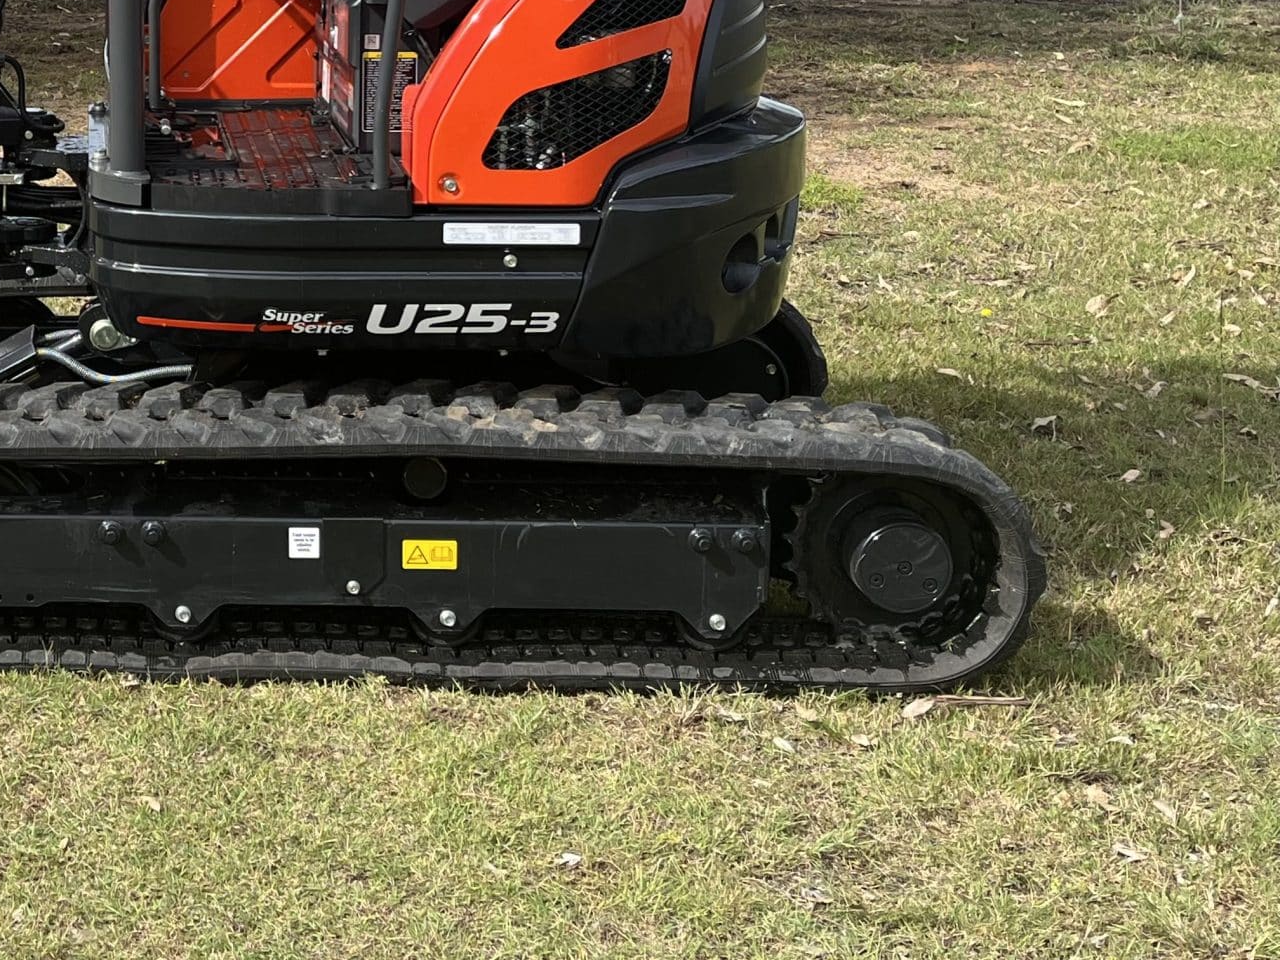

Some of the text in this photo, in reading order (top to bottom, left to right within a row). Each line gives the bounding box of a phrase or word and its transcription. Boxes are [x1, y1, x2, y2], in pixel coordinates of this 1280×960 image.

[263, 309, 324, 323] Super
[365, 303, 560, 334] U25-3
[291, 322, 354, 334] Series
